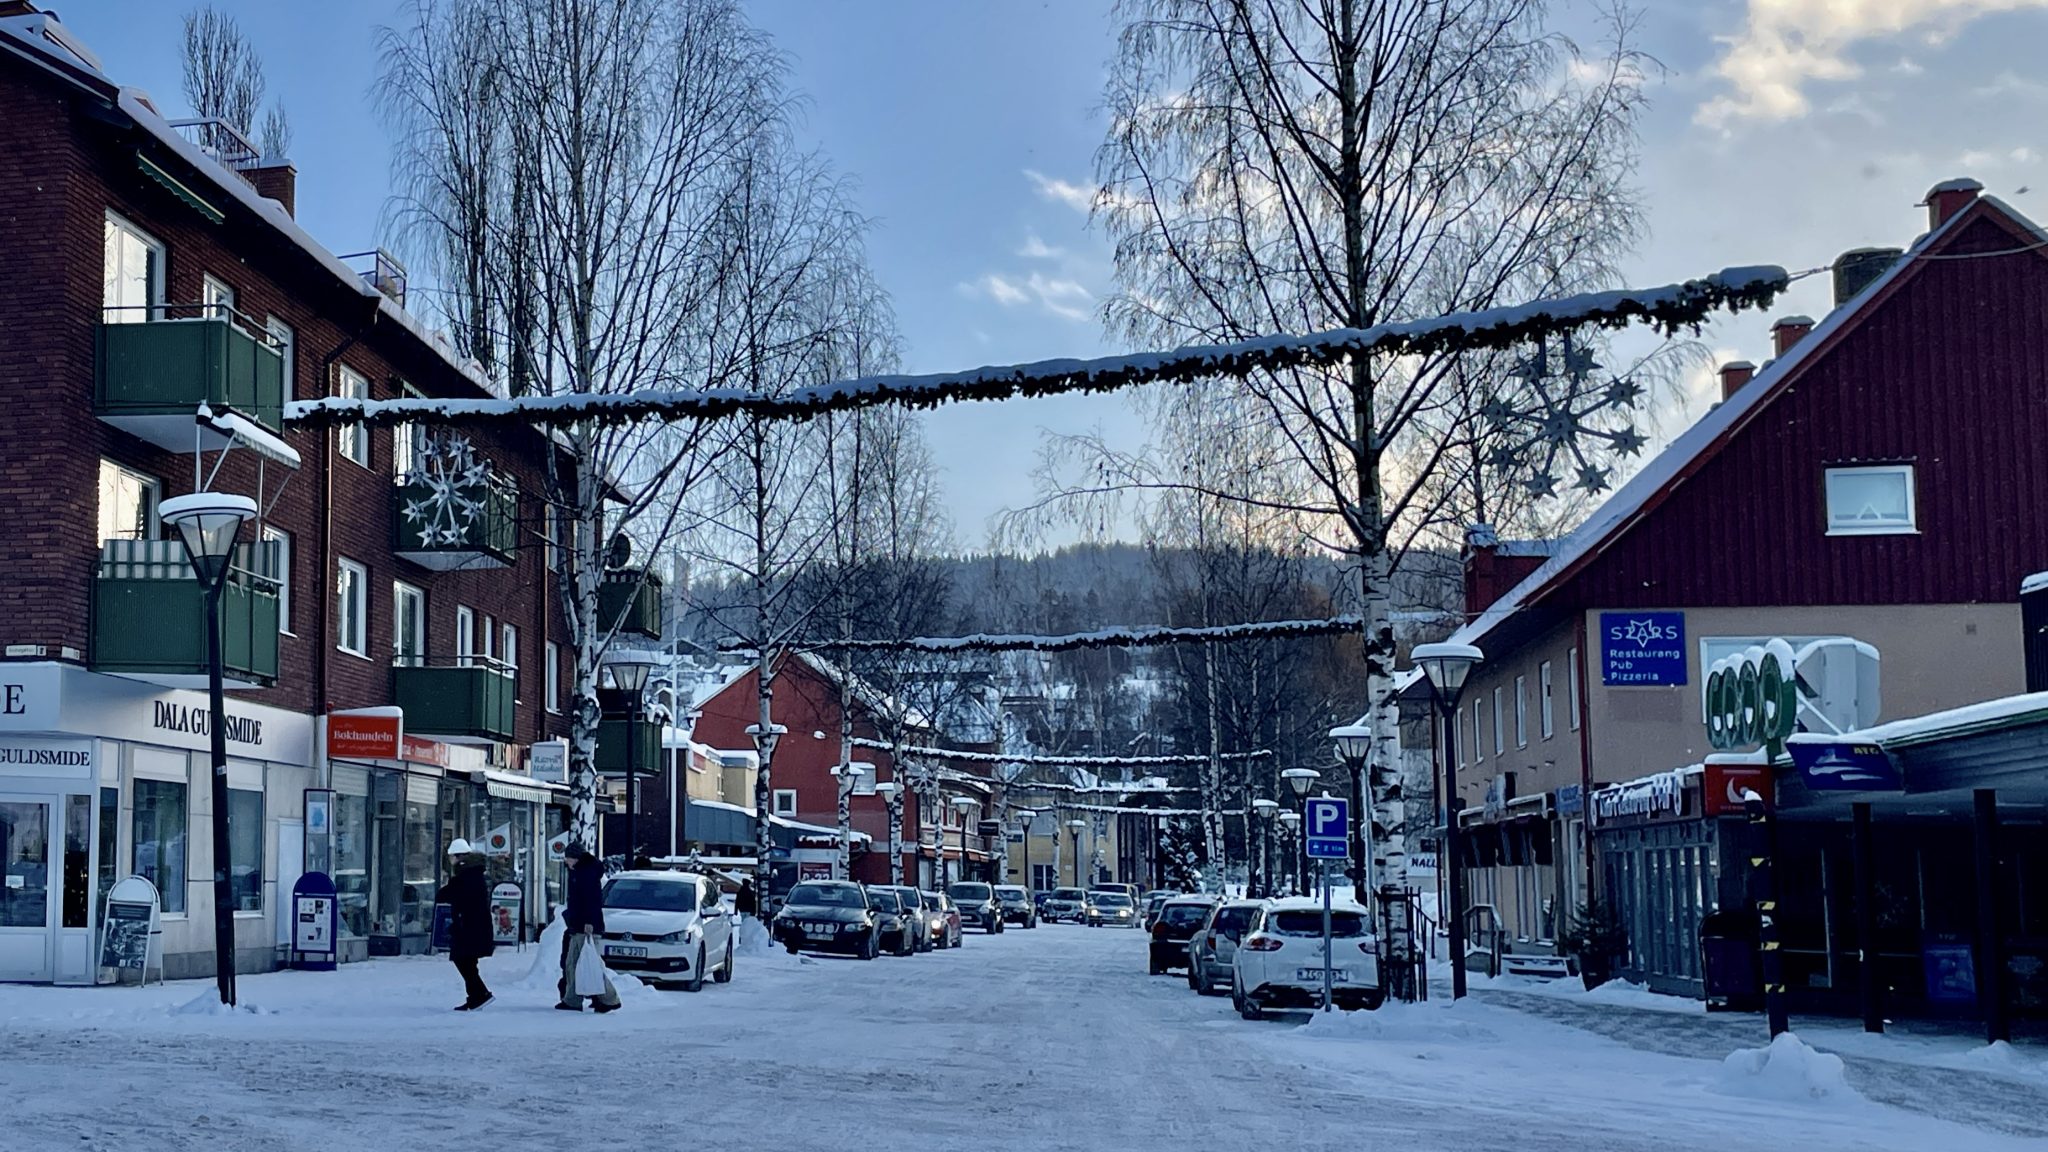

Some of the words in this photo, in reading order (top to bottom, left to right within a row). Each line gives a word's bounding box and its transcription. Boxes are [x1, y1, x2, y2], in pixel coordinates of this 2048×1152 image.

[1610, 625, 1678, 641] STARS
[1610, 649, 1680, 659] Restaurang
[1610, 661, 1633, 670] Pub
[1611, 672, 1659, 681] Pizzeria
[0, 684, 26, 714] E
[154, 700, 189, 733] DALA
[191, 708, 262, 745] GUSMIDE
[333, 729, 393, 743] Bokhandeln
[1316, 804, 1338, 834] P
